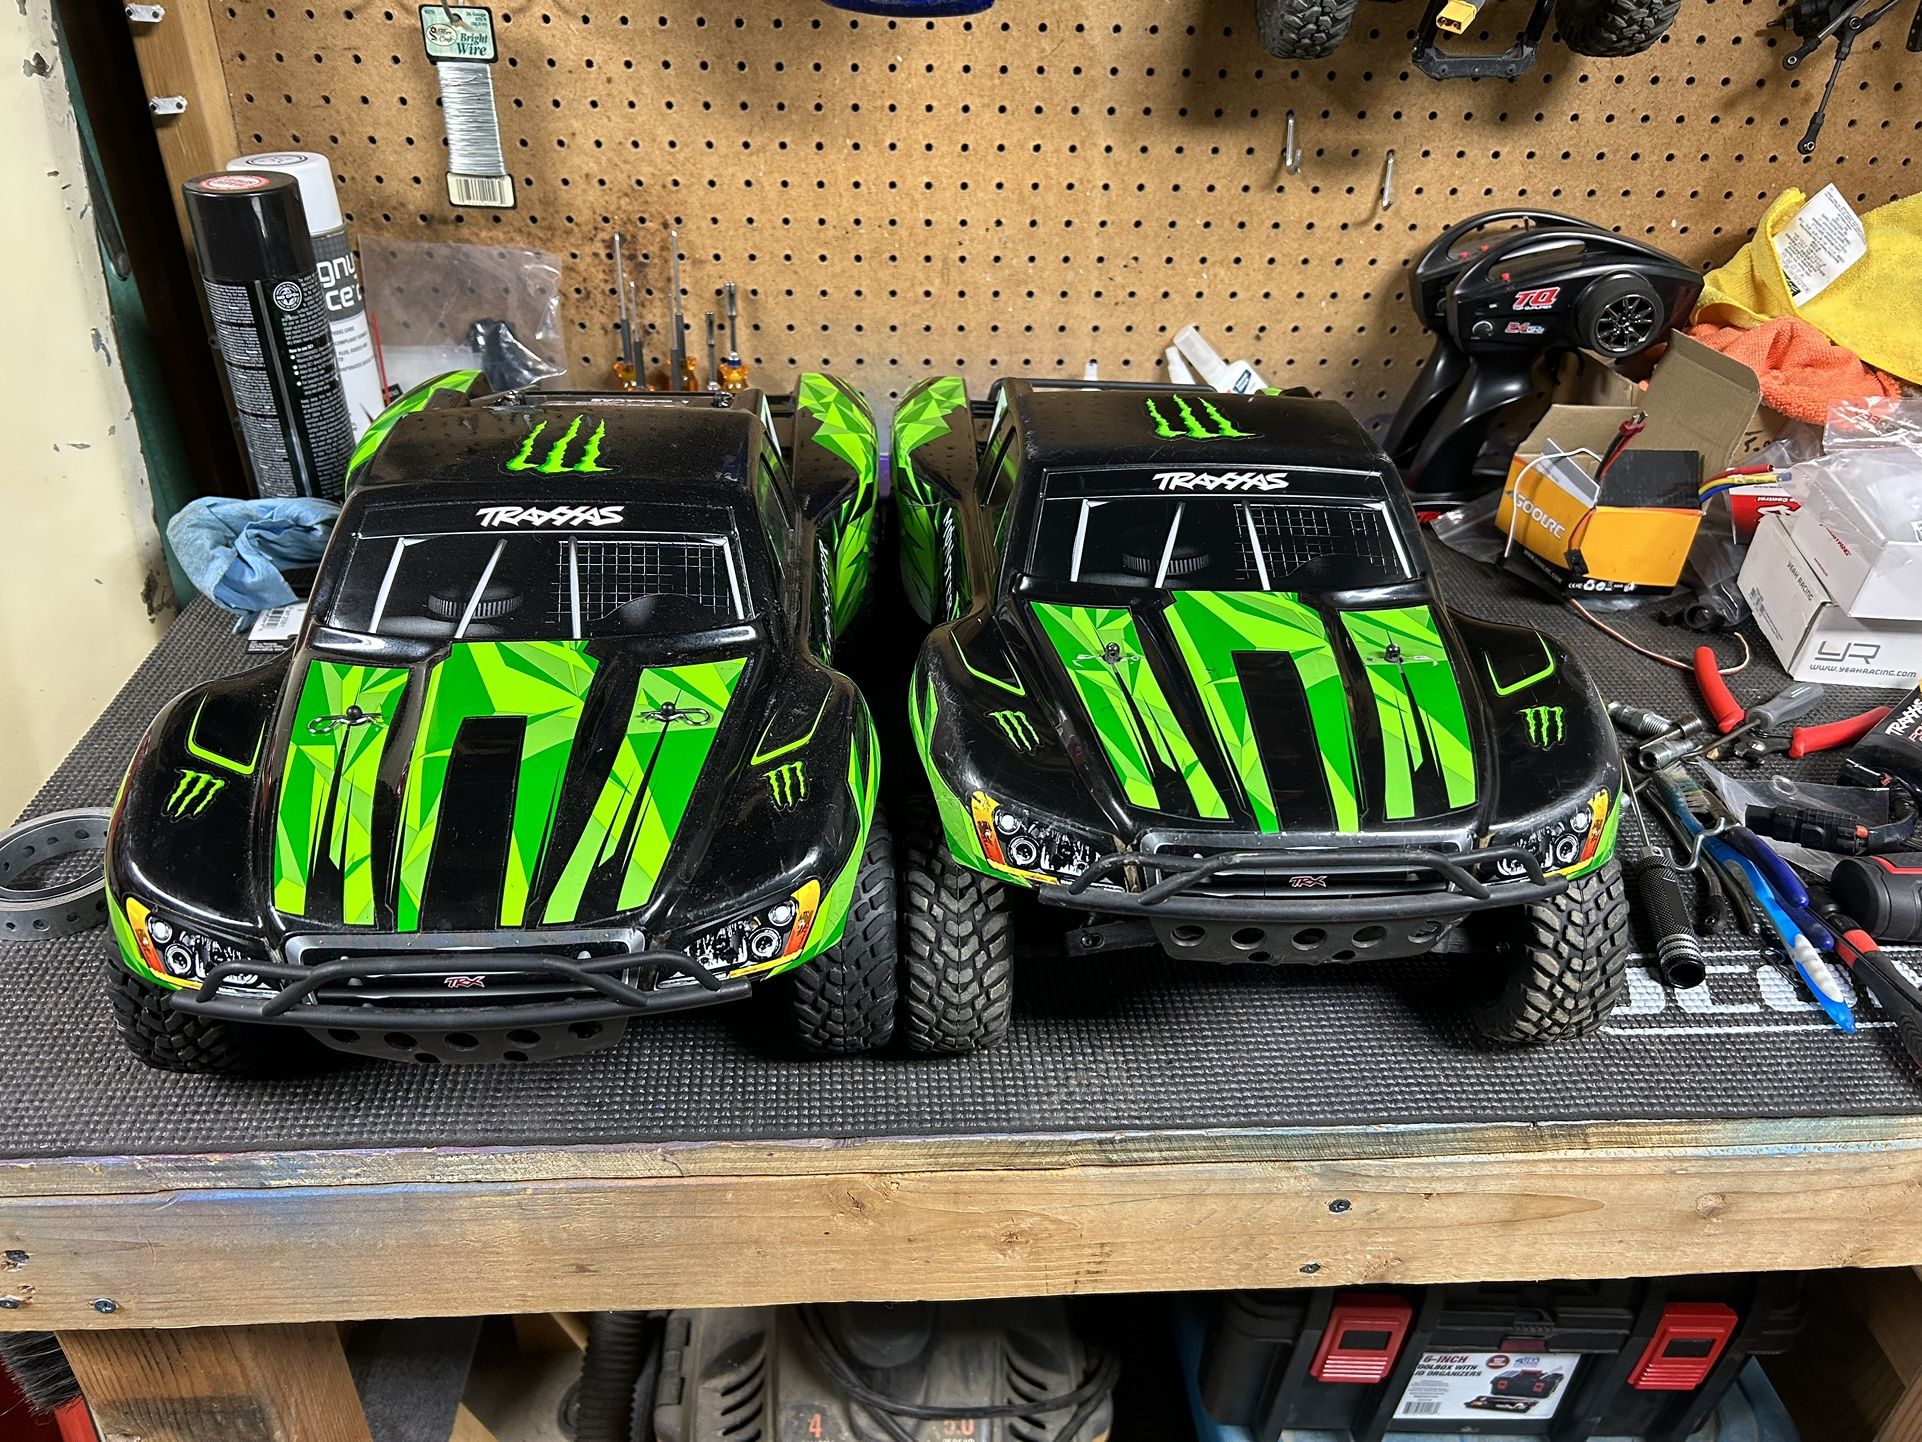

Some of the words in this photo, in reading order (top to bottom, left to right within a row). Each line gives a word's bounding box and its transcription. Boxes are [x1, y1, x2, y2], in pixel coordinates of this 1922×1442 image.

[457, 42, 487, 56] Wire
[460, 33, 488, 45] Bright
[1512, 286, 1560, 308] TQ
[1152, 471, 1290, 491] TRAXXAS
[475, 505, 625, 527] TRAXXAS
[1786, 560, 1799, 580] YEAH
[1798, 577, 1814, 601] RACING
[1814, 640, 1881, 665] YR
[808, 1413, 823, 1439] 4
